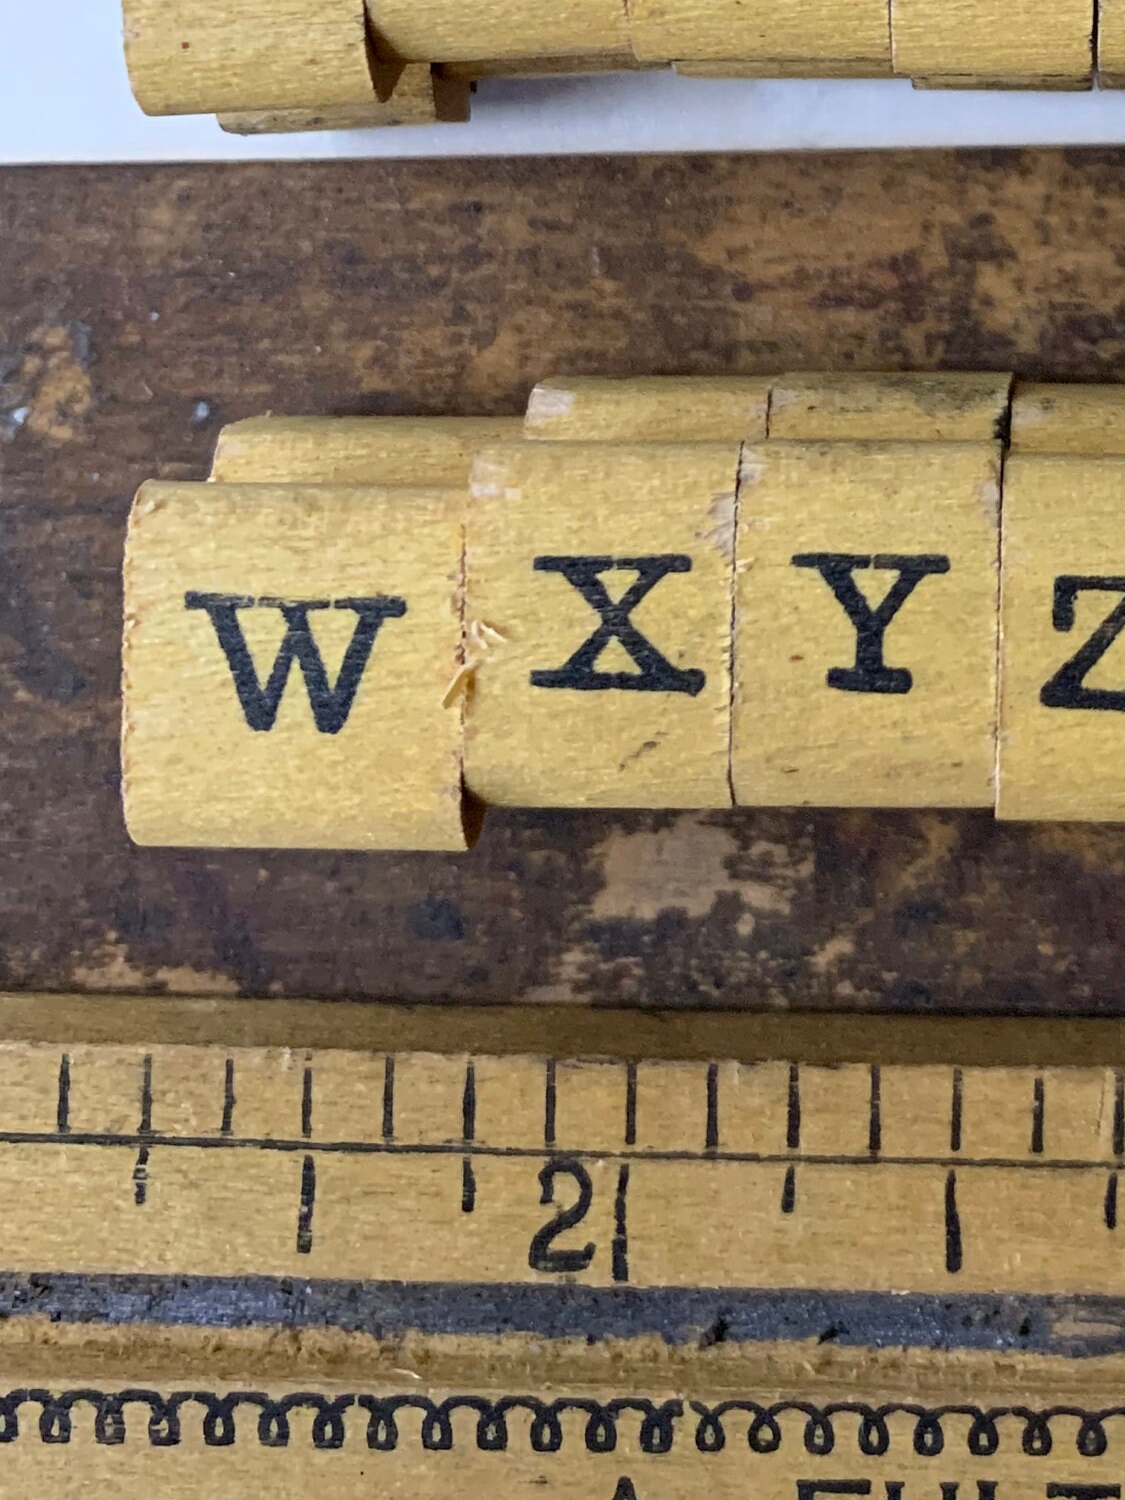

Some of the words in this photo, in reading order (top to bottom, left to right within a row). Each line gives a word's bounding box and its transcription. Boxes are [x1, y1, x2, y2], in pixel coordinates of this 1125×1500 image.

[186, 593, 406, 734] W
[531, 555, 705, 696] X
[792, 553, 950, 694] Y
[528, 1157, 596, 1273] 2
